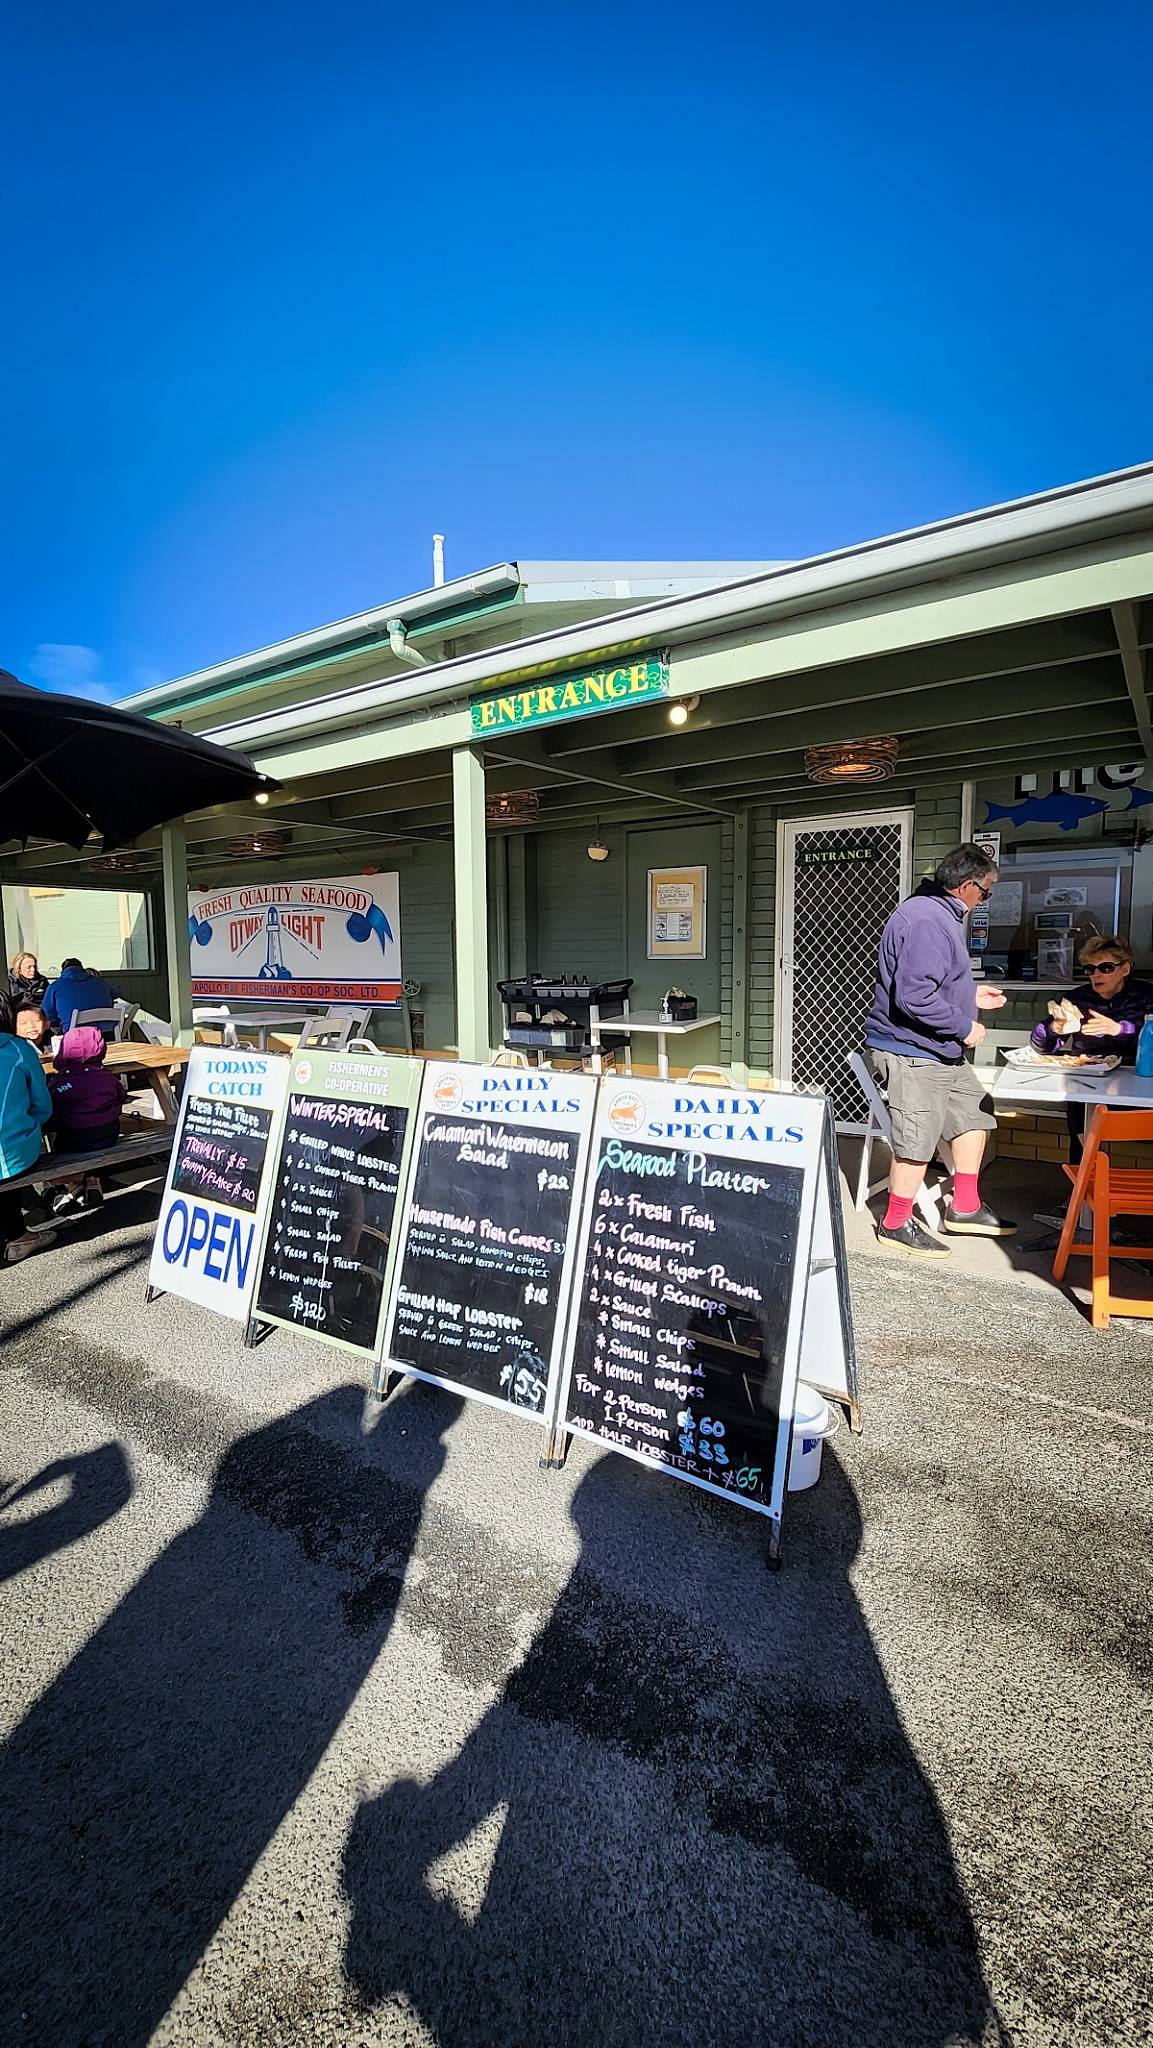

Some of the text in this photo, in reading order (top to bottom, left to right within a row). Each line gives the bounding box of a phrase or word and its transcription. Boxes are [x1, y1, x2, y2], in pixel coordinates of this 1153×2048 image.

[480, 662, 649, 727] ENTRANCE
[804, 849, 872, 863] ENTRANCE
[199, 886, 368, 920] FRESH QUALITY SEAFOOD
[229, 914, 326, 952] OTWAY LIGHT
[194, 984, 222, 993] APOLLO
[224, 984, 239, 994] BAY
[241, 984, 297, 996] FISHERMAN'S
[300, 985, 330, 997] CO-OP
[334, 986, 358, 998] SOC.
[205, 1060, 267, 1074] TODAYS
[329, 1061, 390, 1078] FISHERMEN'S
[208, 1082, 263, 1096] CATCH
[325, 1078, 390, 1097] CO-OPERATIVE
[482, 1076, 553, 1092] DAILY
[461, 1099, 581, 1113] SPECIALS
[673, 1098, 766, 1115] DAILY
[648, 1122, 805, 1144] SPECIALS
[357, 1153, 400, 1174] LOBSTER
[596, 1139, 677, 1178] Seafood
[309, 1184, 334, 1198] SAUCE
[537, 1168, 570, 1192] $22
[627, 1193, 672, 1223] Fresh
[679, 1204, 717, 1233] Fish
[162, 1199, 255, 1289] OPEN
[316, 1230, 342, 1243] SALAD
[617, 1246, 662, 1272] Cooked
[666, 1257, 706, 1283] tiger
[707, 1264, 763, 1301] Prawn
[288, 1291, 327, 1321] $120
[612, 1295, 651, 1319] Sauce
[611, 1313, 696, 1355] Small Chips
[607, 1338, 706, 1378] Small Salad
[605, 1361, 705, 1401] lemon wedges
[575, 1373, 601, 1397] For
[617, 1394, 668, 1421] Person
[615, 1411, 671, 1441] Person
[571, 1415, 594, 1431] ADD
[599, 1425, 632, 1446] HALF
[636, 1440, 701, 1473] LOBSTER
